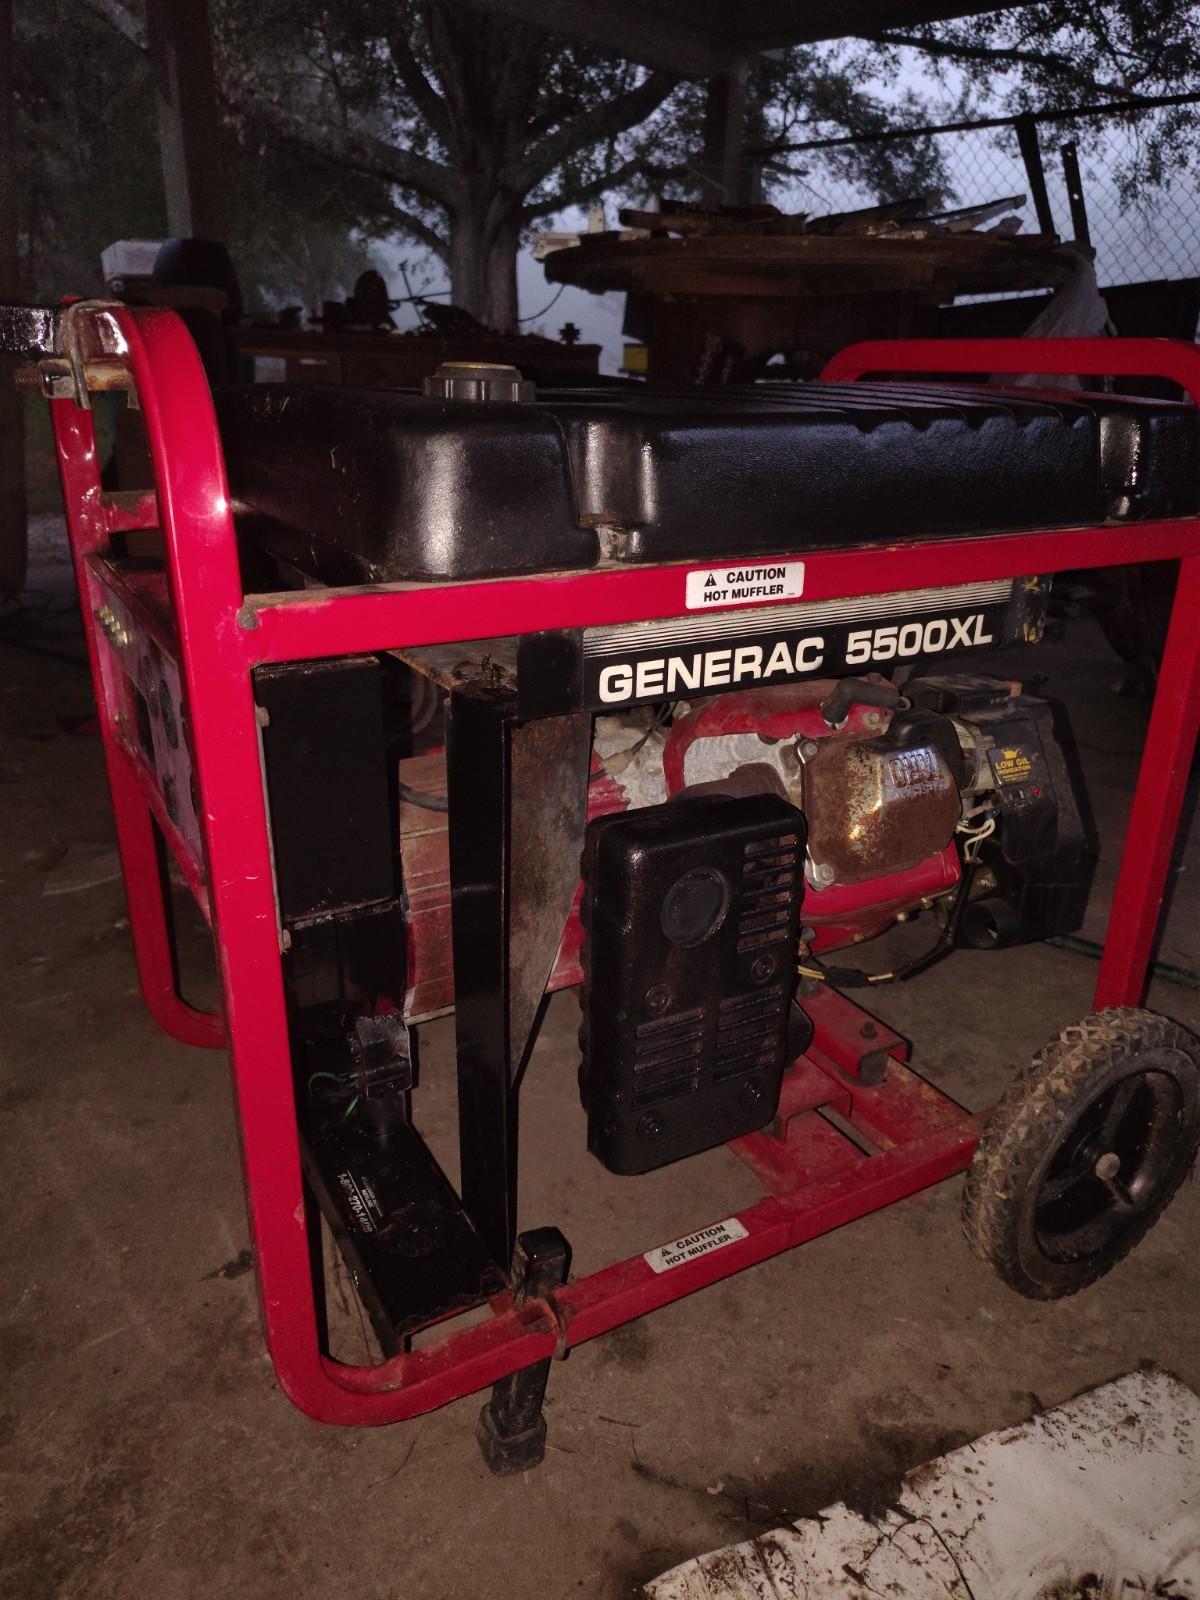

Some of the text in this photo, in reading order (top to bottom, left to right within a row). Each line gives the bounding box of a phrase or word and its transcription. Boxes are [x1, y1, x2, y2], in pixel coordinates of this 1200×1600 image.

[726, 567, 786, 584] CAUTION
[704, 584, 784, 602] HOT MUFFLER
[599, 614, 993, 703] GENERAC 5500XL
[995, 757, 1031, 770] LOW OIL
[676, 1224, 726, 1249] CAUTION
[665, 1234, 732, 1265] HOT MUFFLER
